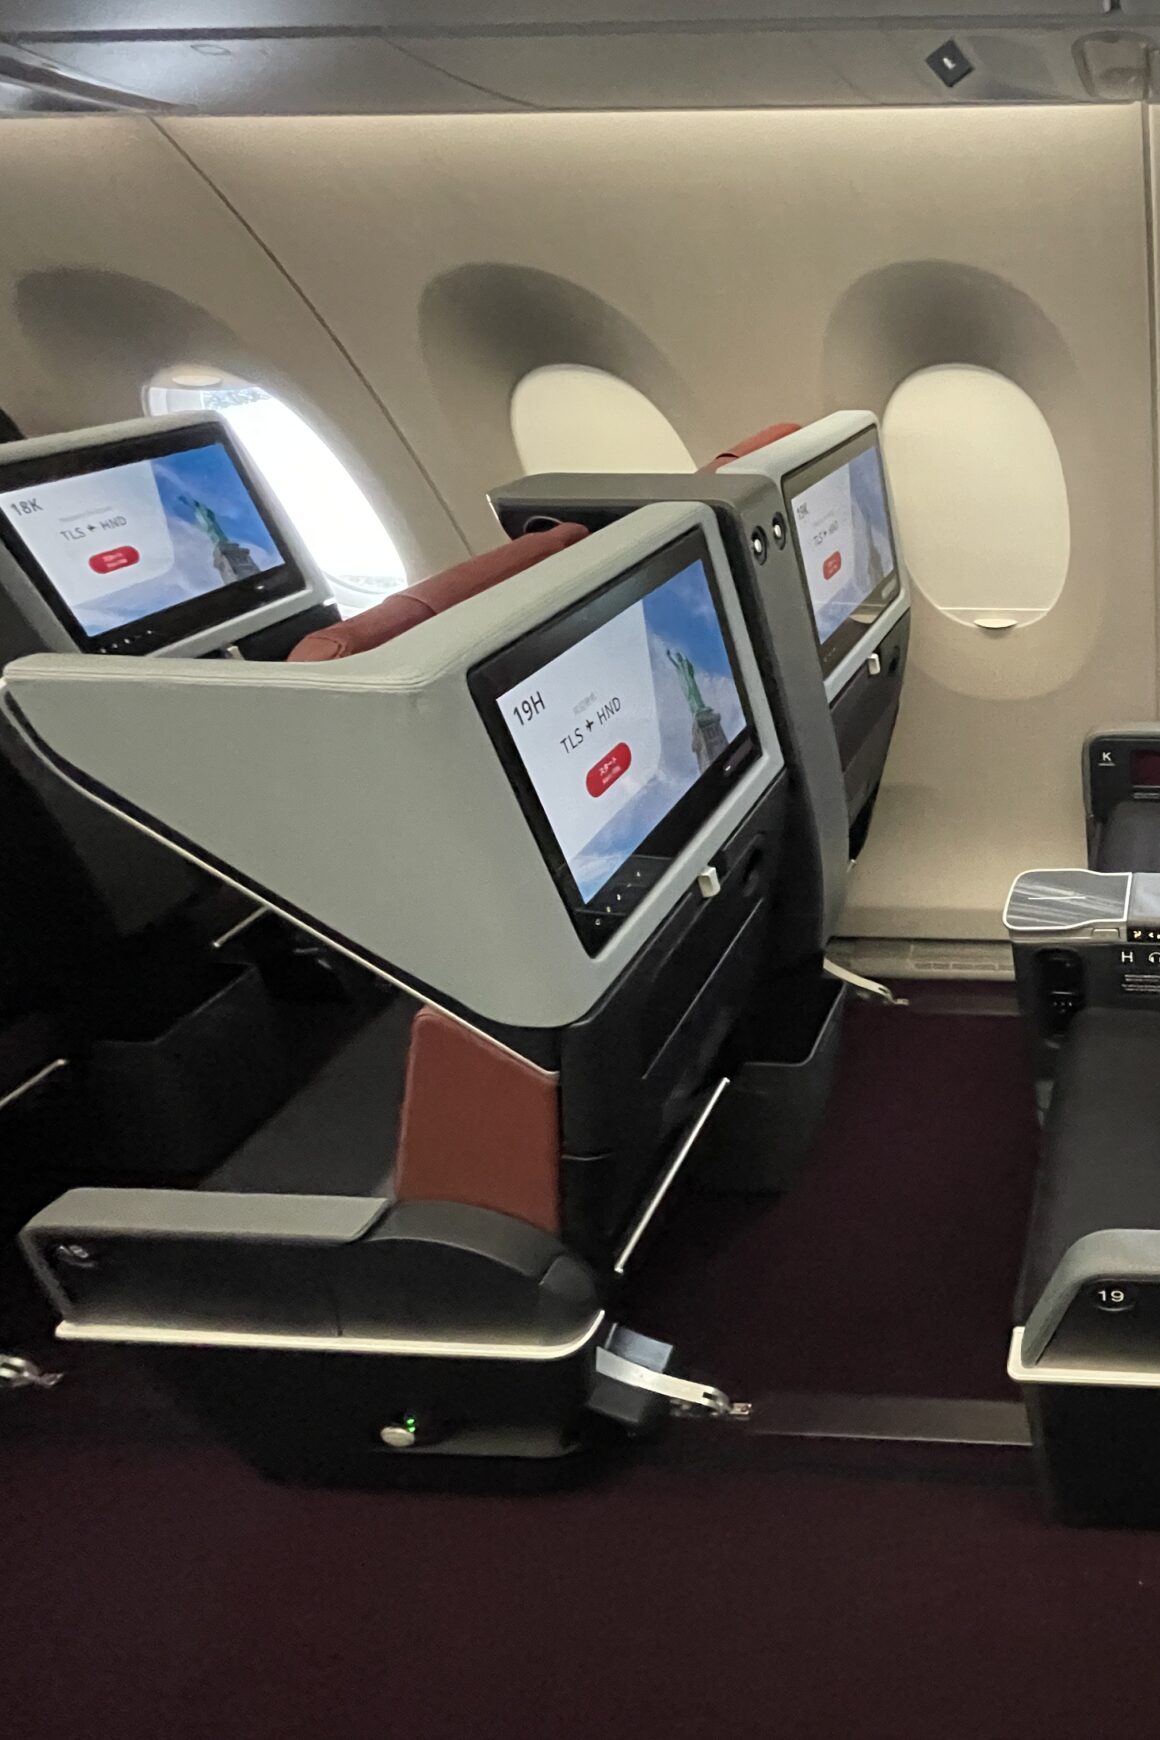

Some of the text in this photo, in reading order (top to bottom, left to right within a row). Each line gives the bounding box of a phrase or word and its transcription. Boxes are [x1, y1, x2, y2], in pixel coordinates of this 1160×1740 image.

[10, 498, 43, 516] 18K
[60, 515, 127, 541] TLS HND
[513, 691, 546, 726] 19H
[560, 727, 584, 754] TLS
[597, 697, 621, 725] HND
[1102, 751, 1112, 762] K
[1121, 951, 1133, 963] H
[1097, 1290, 1125, 1302] 19
